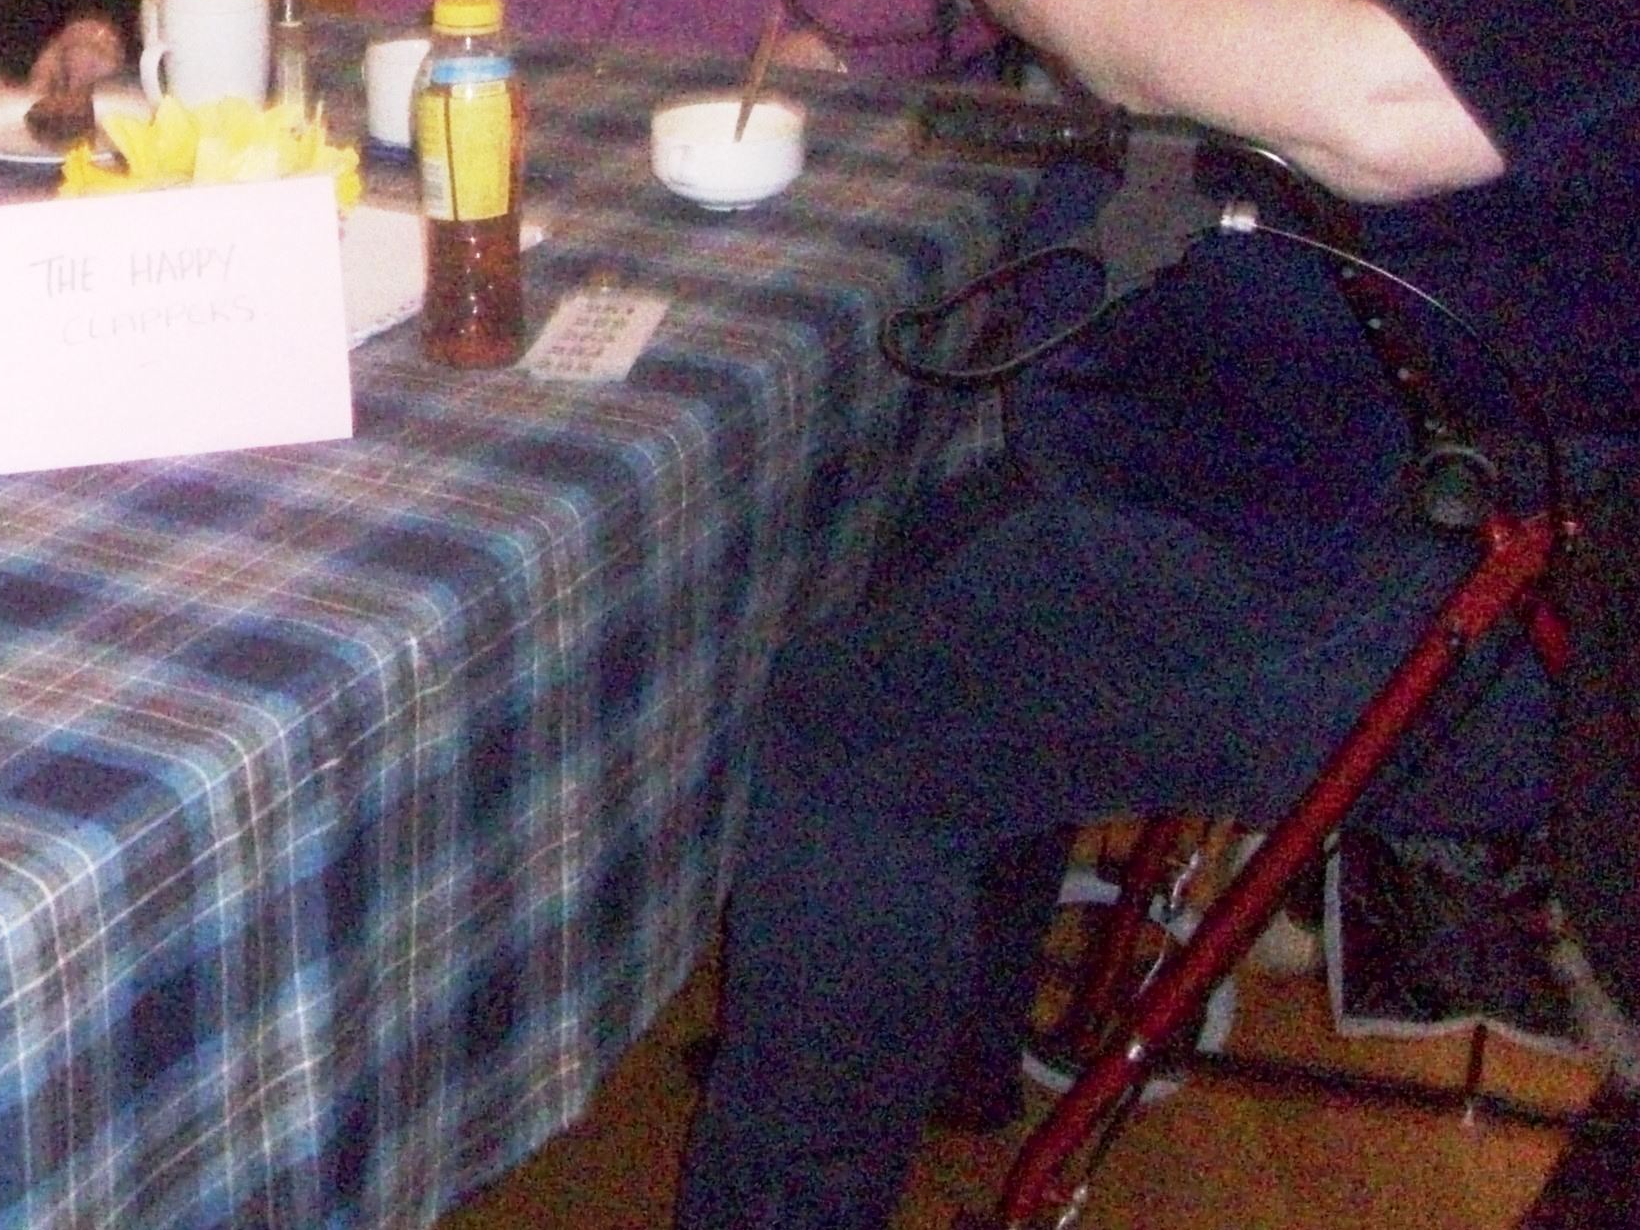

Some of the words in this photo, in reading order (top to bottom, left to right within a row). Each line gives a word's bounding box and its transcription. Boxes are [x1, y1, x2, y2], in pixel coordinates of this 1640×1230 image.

[28, 253, 96, 298] THE
[129, 243, 236, 287] HAPPY
[61, 292, 255, 347] CLAPPERS
